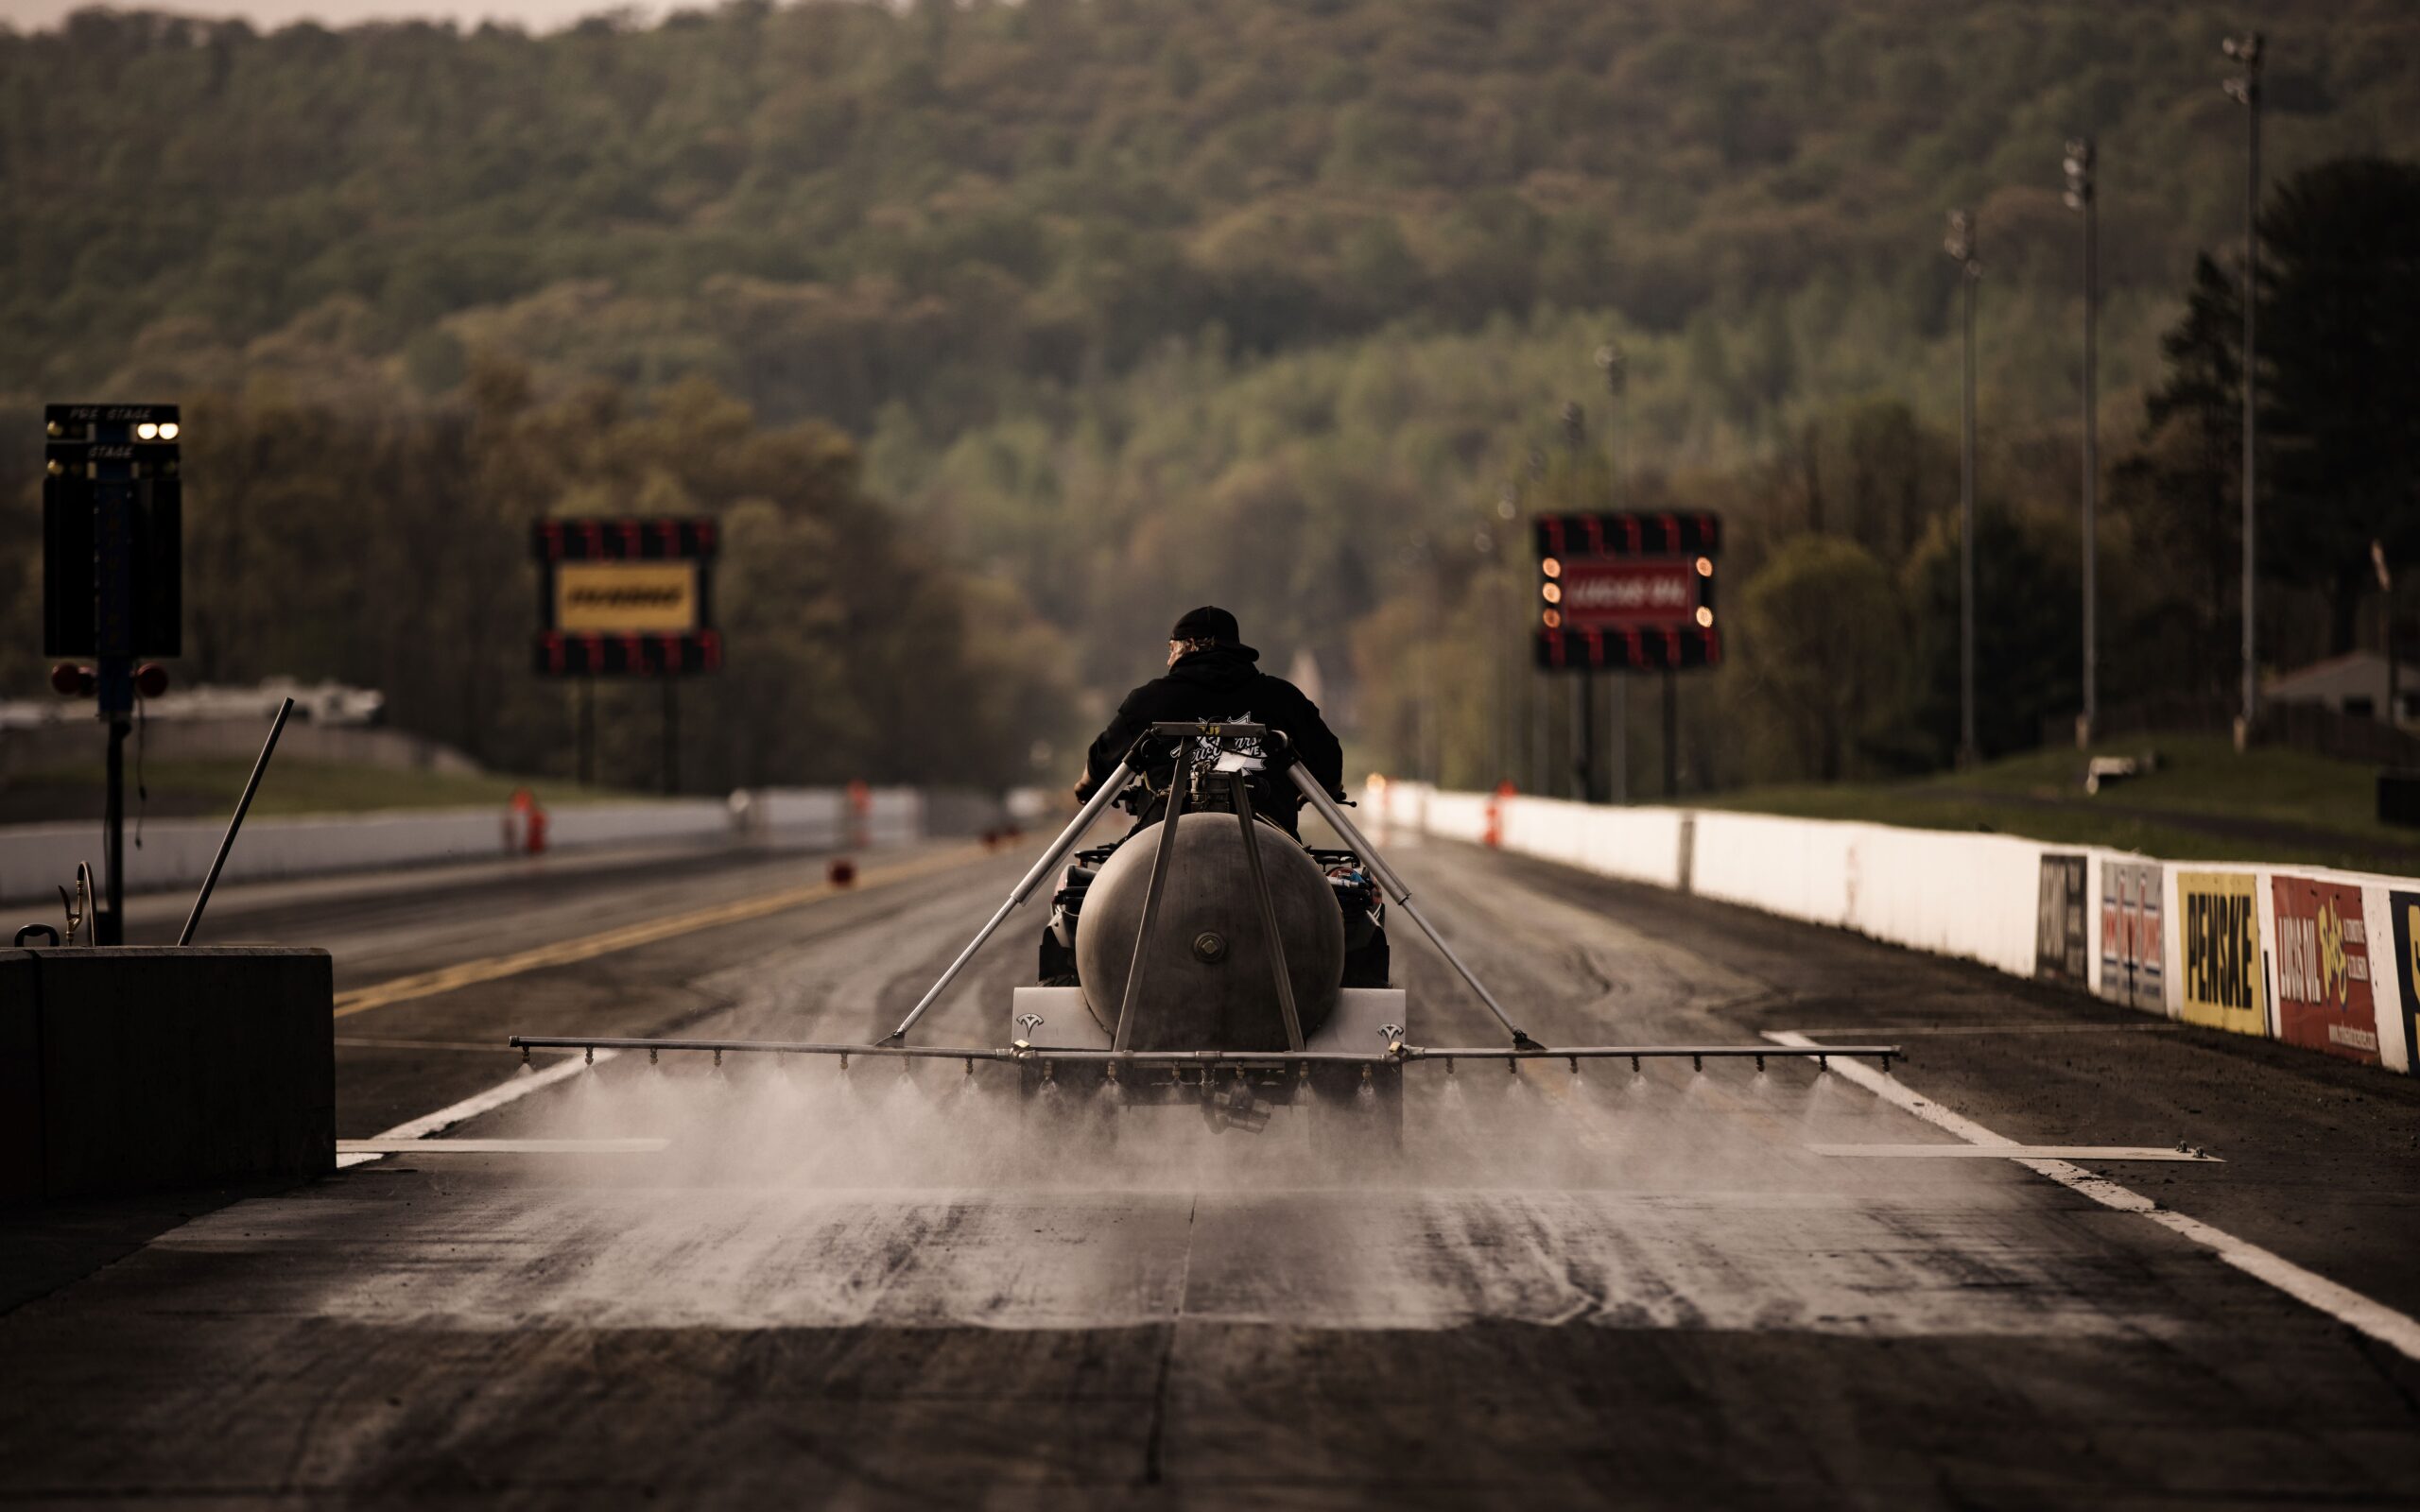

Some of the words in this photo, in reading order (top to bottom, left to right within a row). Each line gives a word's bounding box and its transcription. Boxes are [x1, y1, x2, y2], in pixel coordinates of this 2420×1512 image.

[89, 445, 132, 458] STAGE
[2187, 892, 2254, 1010] PENSKE
[2278, 917, 2305, 1003] LUCAS
[2303, 918, 2322, 1004] OIL
